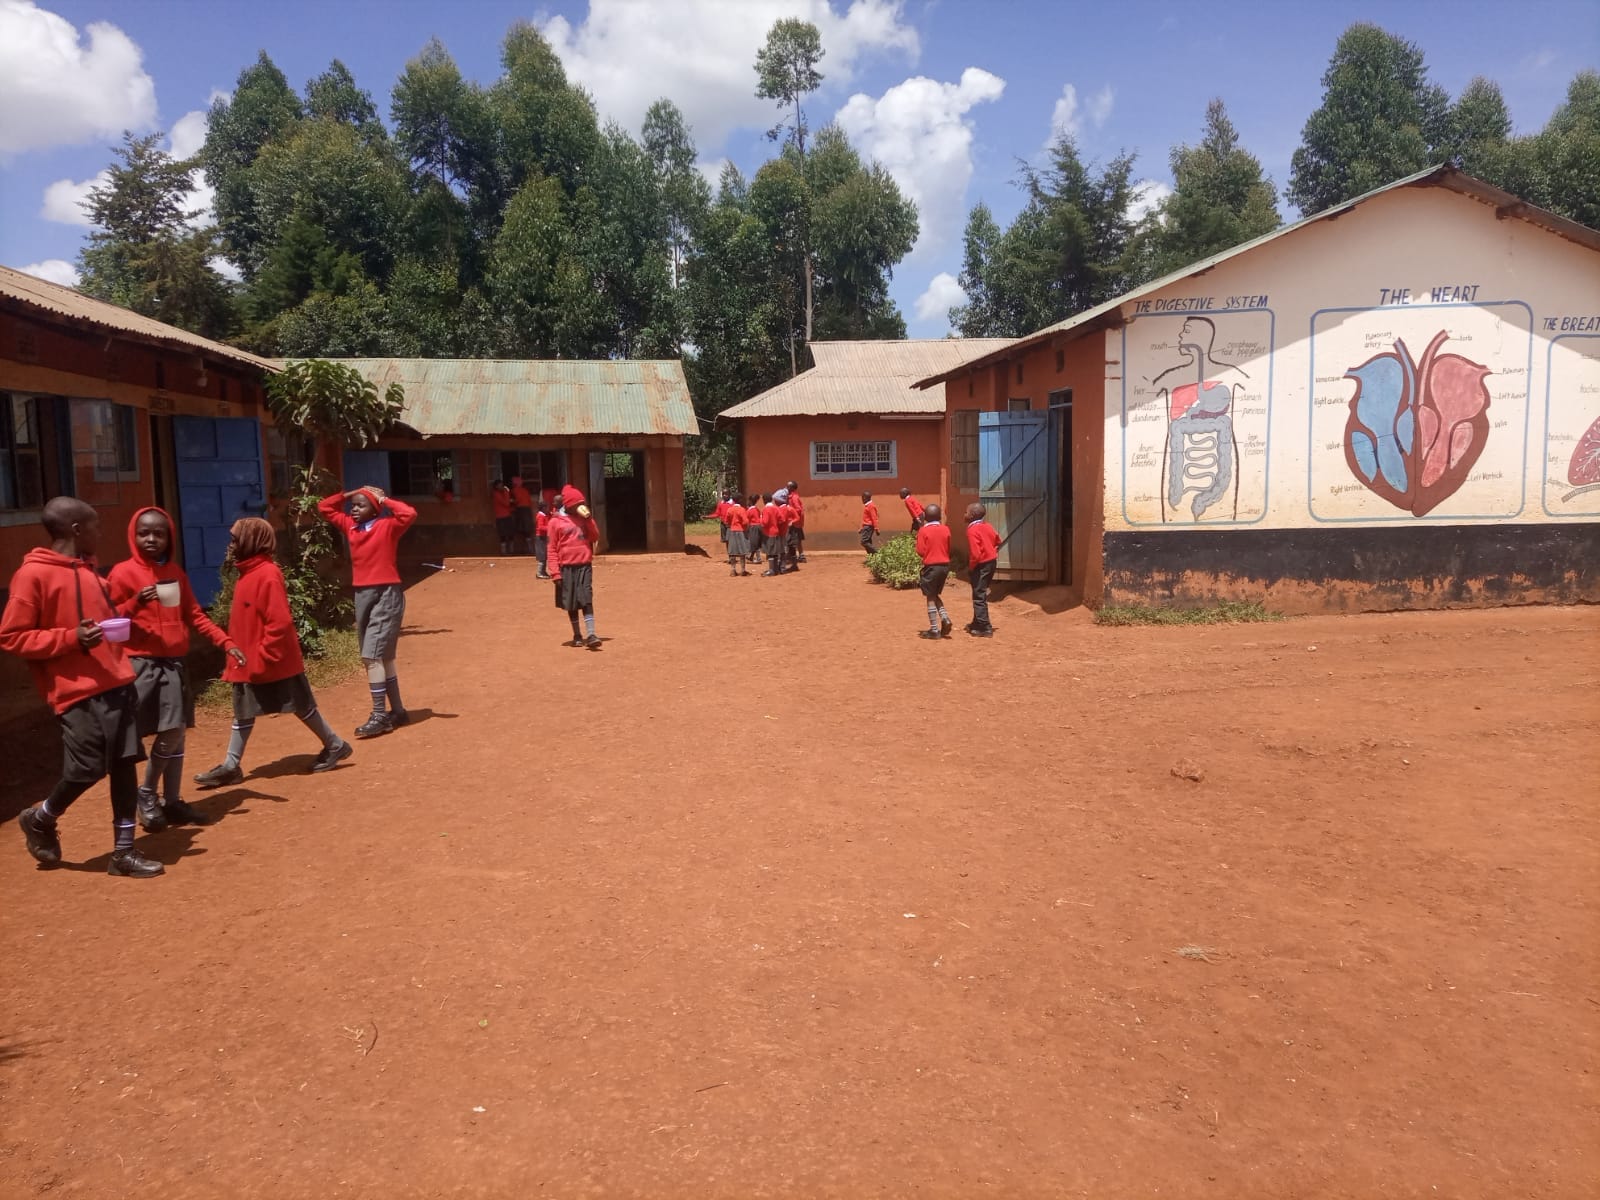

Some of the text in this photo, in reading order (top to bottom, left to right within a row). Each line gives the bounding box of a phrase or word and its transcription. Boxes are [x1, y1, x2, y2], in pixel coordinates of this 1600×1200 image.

[1134, 295, 1269, 313] THE DIGESTIVE SYSTEM
[1379, 285, 1480, 305] THE HEART
[1543, 317, 1558, 331] THE
